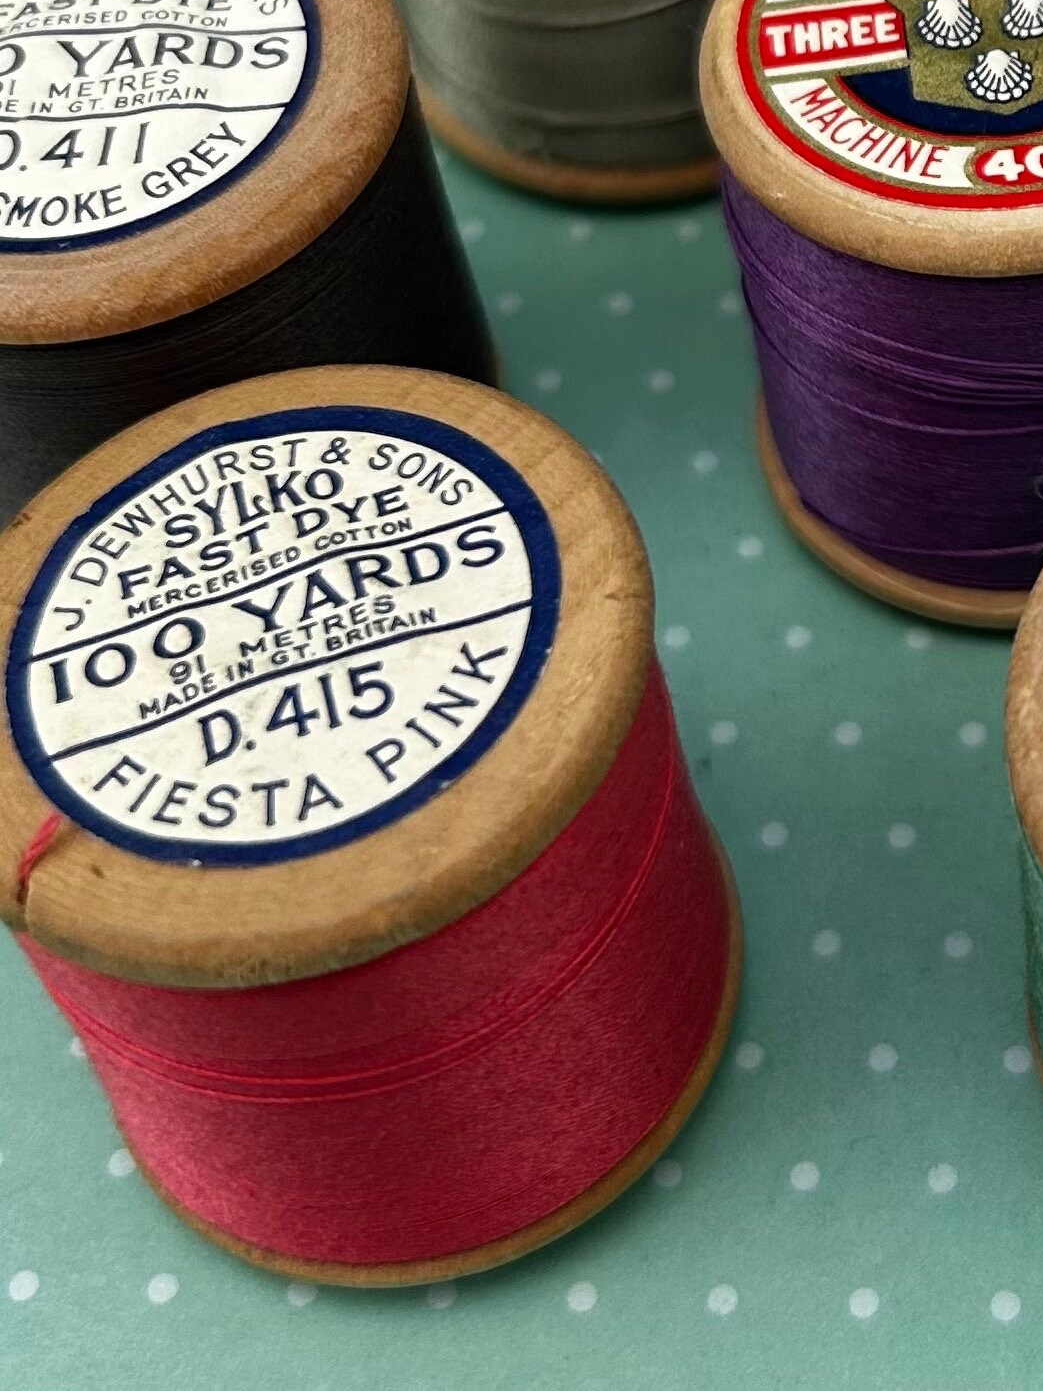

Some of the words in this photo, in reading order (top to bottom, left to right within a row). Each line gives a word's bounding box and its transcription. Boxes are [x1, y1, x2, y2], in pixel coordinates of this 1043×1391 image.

[57, 32, 290, 78] YARDS
[141, 9, 229, 29] COTTON
[765, 11, 901, 58] THREE
[30, 101, 54, 115] IN
[114, 86, 210, 110] BRITAIN
[48, 68, 181, 99] METRES
[141, 120, 248, 200] GREY
[790, 83, 950, 180] MACHINE
[320, 436, 352, 466] &
[367, 441, 475, 507] SONS
[70, 437, 308, 589] DEWHURST
[117, 523, 271, 600] FAST
[292, 484, 410, 539] DYE
[164, 468, 344, 550] SYLKO
[127, 545, 302, 619] MERCERISED
[313, 516, 414, 552] COTTON
[47, 615, 207, 704] 100
[231, 524, 507, 634] YARDS
[53, 597, 93, 632] J.
[169, 653, 208, 685] 91
[239, 593, 397, 658] METRES
[138, 672, 217, 720] MADE
[227, 659, 255, 682] IN
[325, 606, 439, 652] BRITAIN
[92, 754, 345, 829] FIESTA
[364, 640, 510, 783] PINK
[198, 660, 396, 768] D.415
